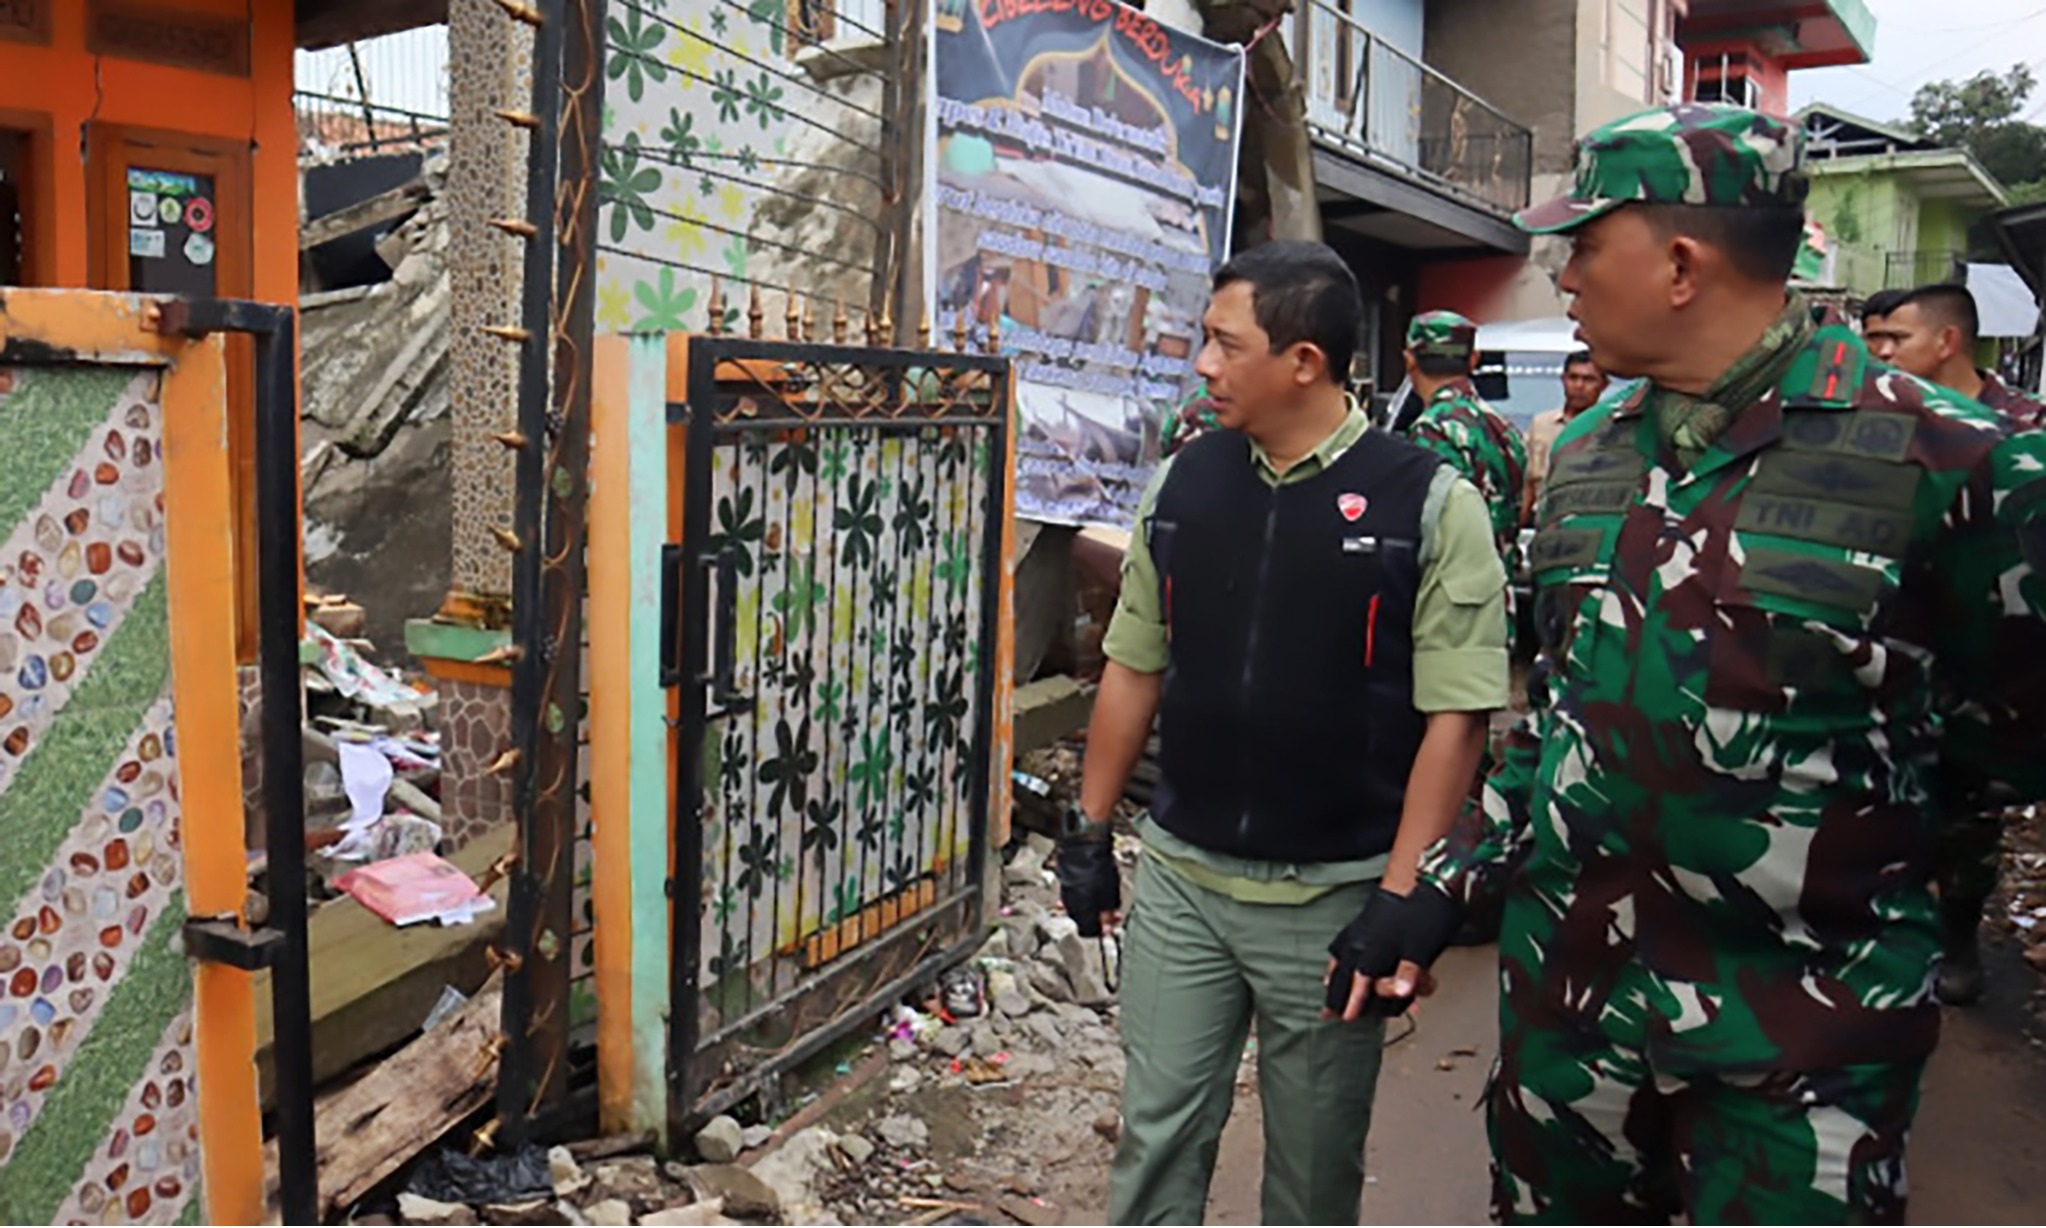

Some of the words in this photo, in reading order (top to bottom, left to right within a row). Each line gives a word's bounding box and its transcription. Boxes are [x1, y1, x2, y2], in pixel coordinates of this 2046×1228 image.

[1114, 6, 1200, 115] BERDUKA
[1756, 500, 1817, 530] TNI
[1837, 511, 1897, 545] AD
